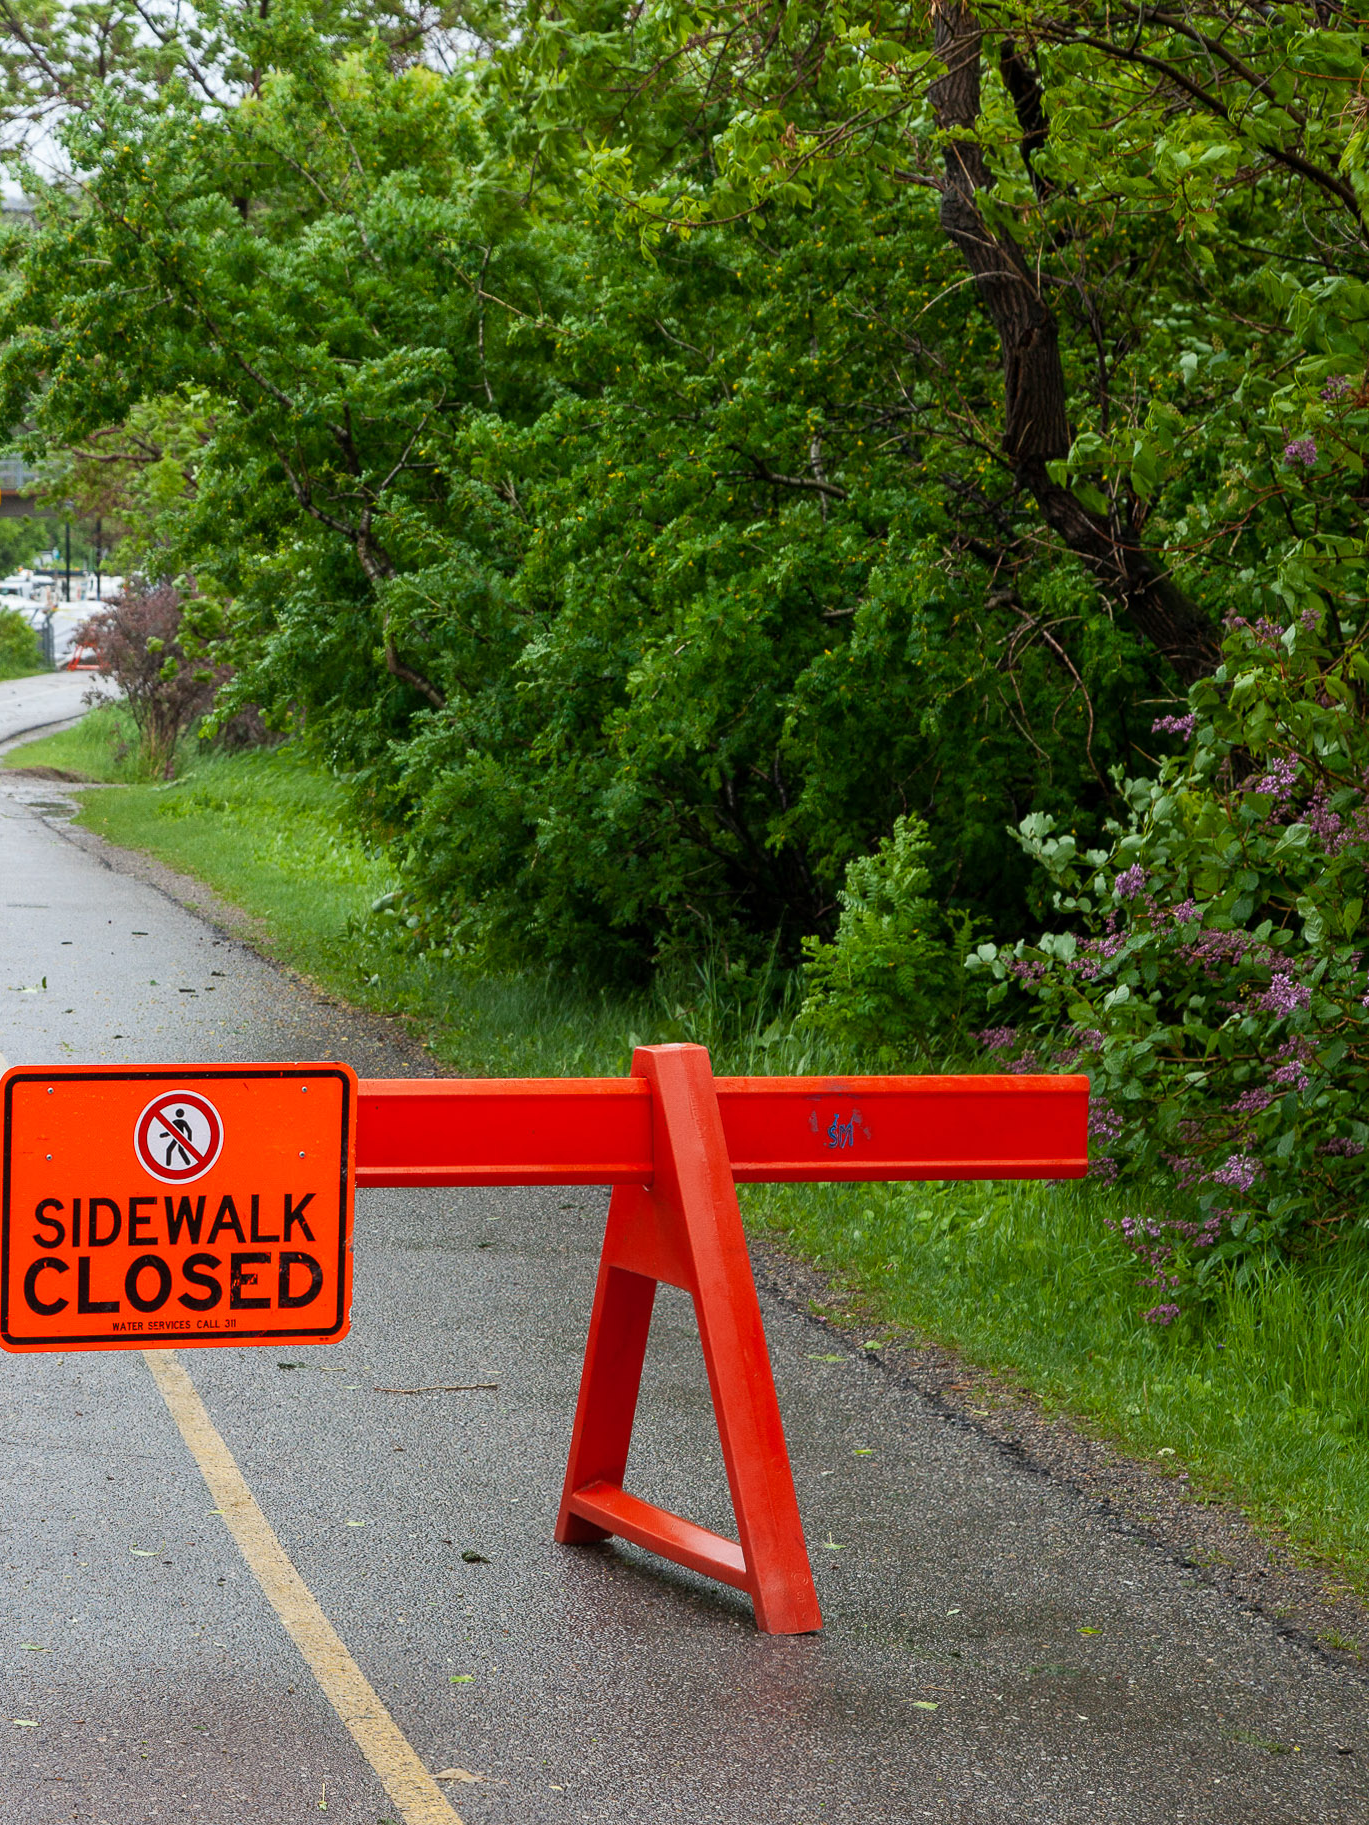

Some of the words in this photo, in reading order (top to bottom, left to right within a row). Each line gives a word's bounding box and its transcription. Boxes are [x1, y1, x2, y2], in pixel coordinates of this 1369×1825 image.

[32, 1193, 317, 1249] SIDEWALK
[23, 1251, 324, 1316] CLOSED
[112, 1321, 144, 1331] WATER
[148, 1320, 191, 1330] SERVICES
[196, 1319, 220, 1329] CALL
[224, 1318, 237, 1328] 311
